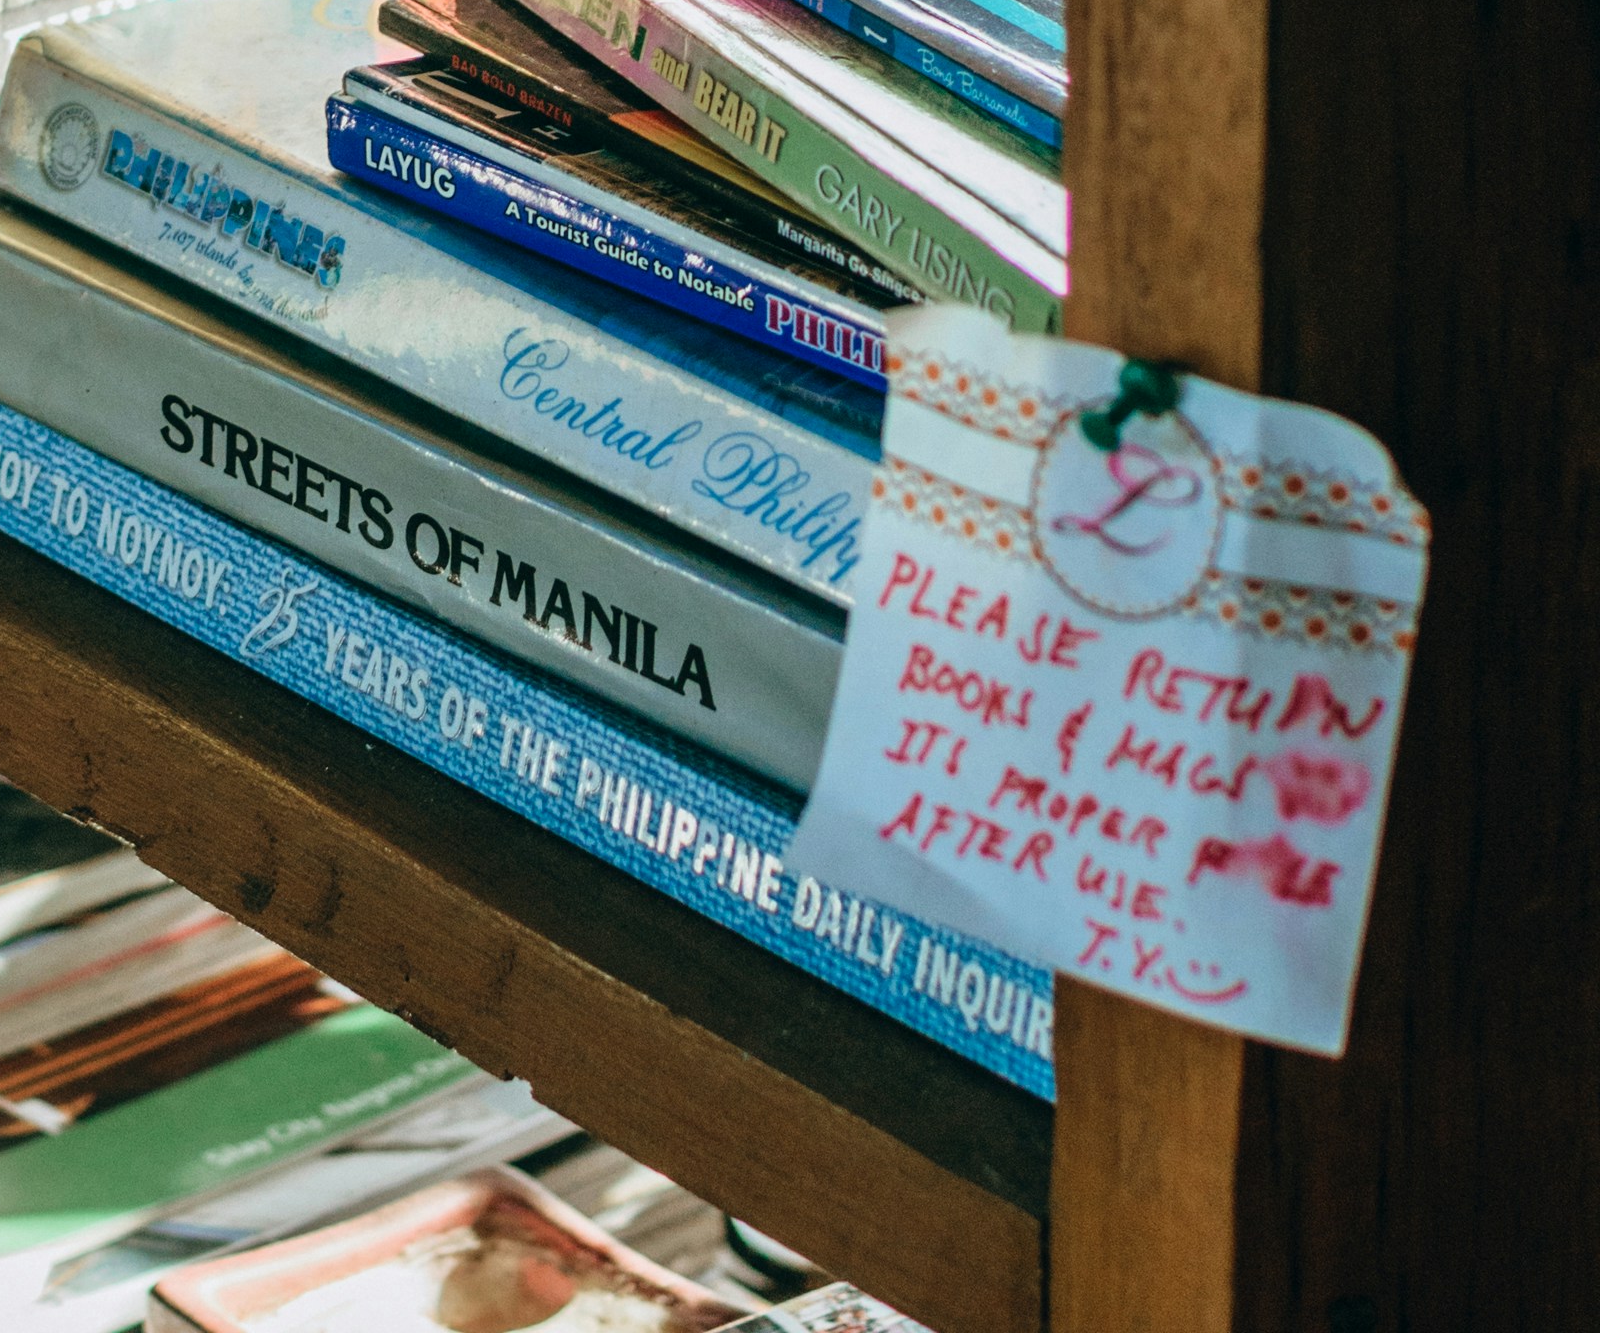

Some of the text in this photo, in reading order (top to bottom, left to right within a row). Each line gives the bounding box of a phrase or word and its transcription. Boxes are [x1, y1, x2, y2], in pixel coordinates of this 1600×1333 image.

[451, 54, 573, 128] BAD BOLD BRAZEN
[916, 48, 955, 92] Bong
[956, 69, 1030, 130] Barrameda
[103, 128, 347, 291] PHILIPPINES
[365, 137, 457, 200] LAYUG
[650, 46, 691, 93] and
[693, 66, 758, 147] BEAR
[756, 115, 786, 165] IT
[813, 164, 906, 248] GARY
[908, 228, 1016, 333] LISING
[195, 237, 239, 271] islands
[504, 200, 521, 221] A
[525, 207, 590, 249] Tourist
[592, 234, 651, 272] Guide
[653, 259, 674, 281] to
[677, 265, 755, 312] Notable
[776, 218, 845, 267] Margarita
[499, 325, 704, 471] Central
[160, 393, 718, 712] STREETS OF MANILA
[877, 552, 1103, 669] PLEASE
[48, 474, 90, 538] TO
[96, 500, 233, 617] NOYNOY:
[239, 566, 321, 659] 25
[322, 619, 432, 721] YEARS
[438, 684, 489, 750] OF
[499, 712, 571, 798] THE
[574, 754, 786, 914] PHILIPPINE
[791, 876, 904, 978] DAILY
[882, 718, 1169, 859] ITS PROPER
[897, 643, 1035, 730] BOOKS
[1104, 722, 1261, 804] MAGS
[880, 792, 1056, 881] AFTER
[1075, 855, 1187, 934] USE.
